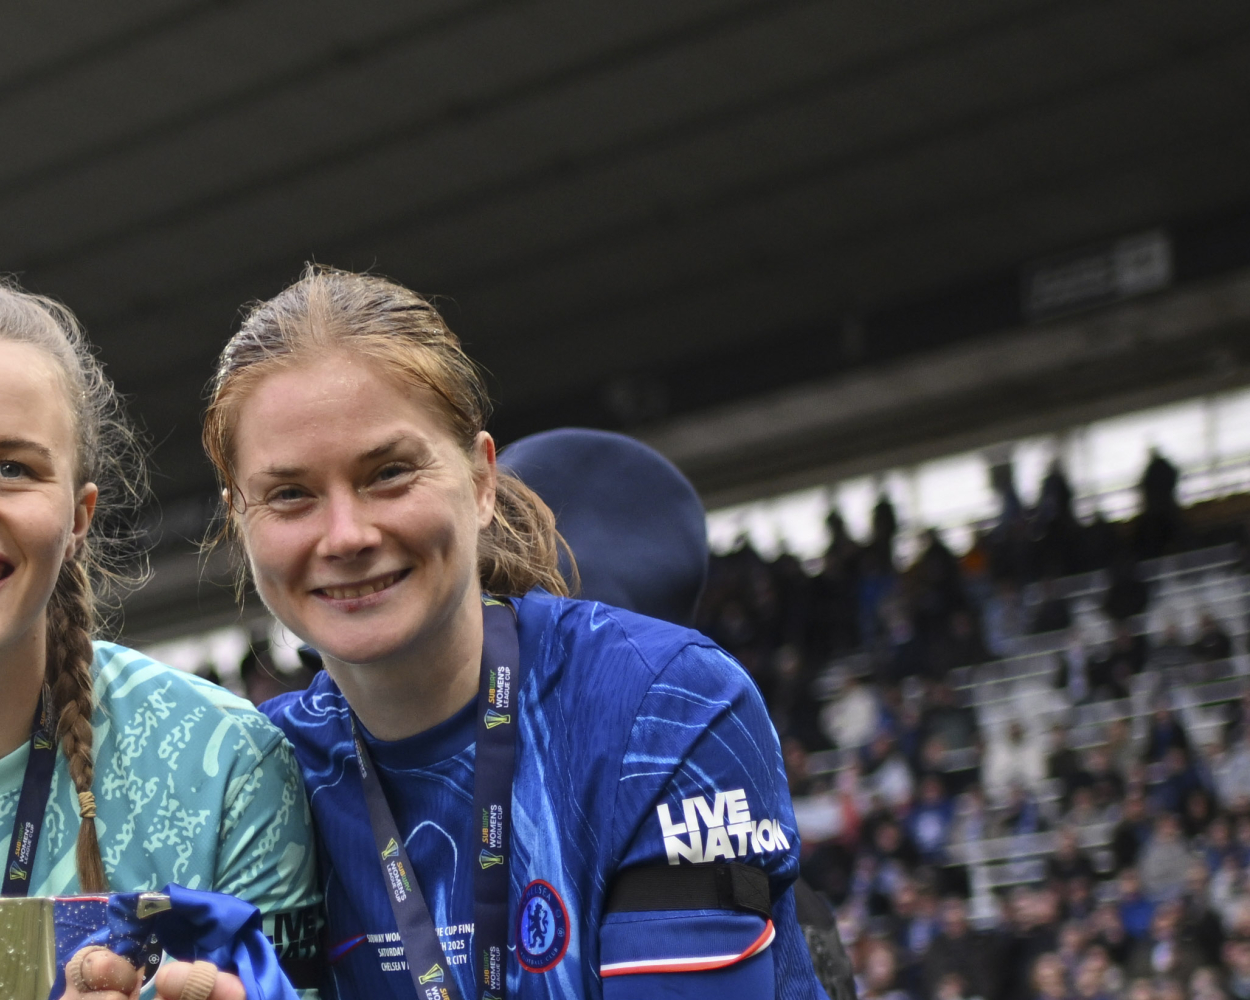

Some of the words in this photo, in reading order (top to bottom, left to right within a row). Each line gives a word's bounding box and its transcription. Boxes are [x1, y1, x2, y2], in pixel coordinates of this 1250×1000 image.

[496, 666, 504, 708] WOMEN'S
[657, 788, 750, 837] LIVE
[19, 822, 31, 862] WOMEN'S
[664, 818, 790, 865] NATION
[391, 860, 406, 901] WOMEN'S
[378, 947, 404, 957] SATURDAY
[448, 940, 465, 950] 2025
[445, 926, 457, 936] CUP
[458, 923, 474, 934] FINA
[381, 962, 401, 971] CHELSEA
[452, 954, 467, 964] CITY
